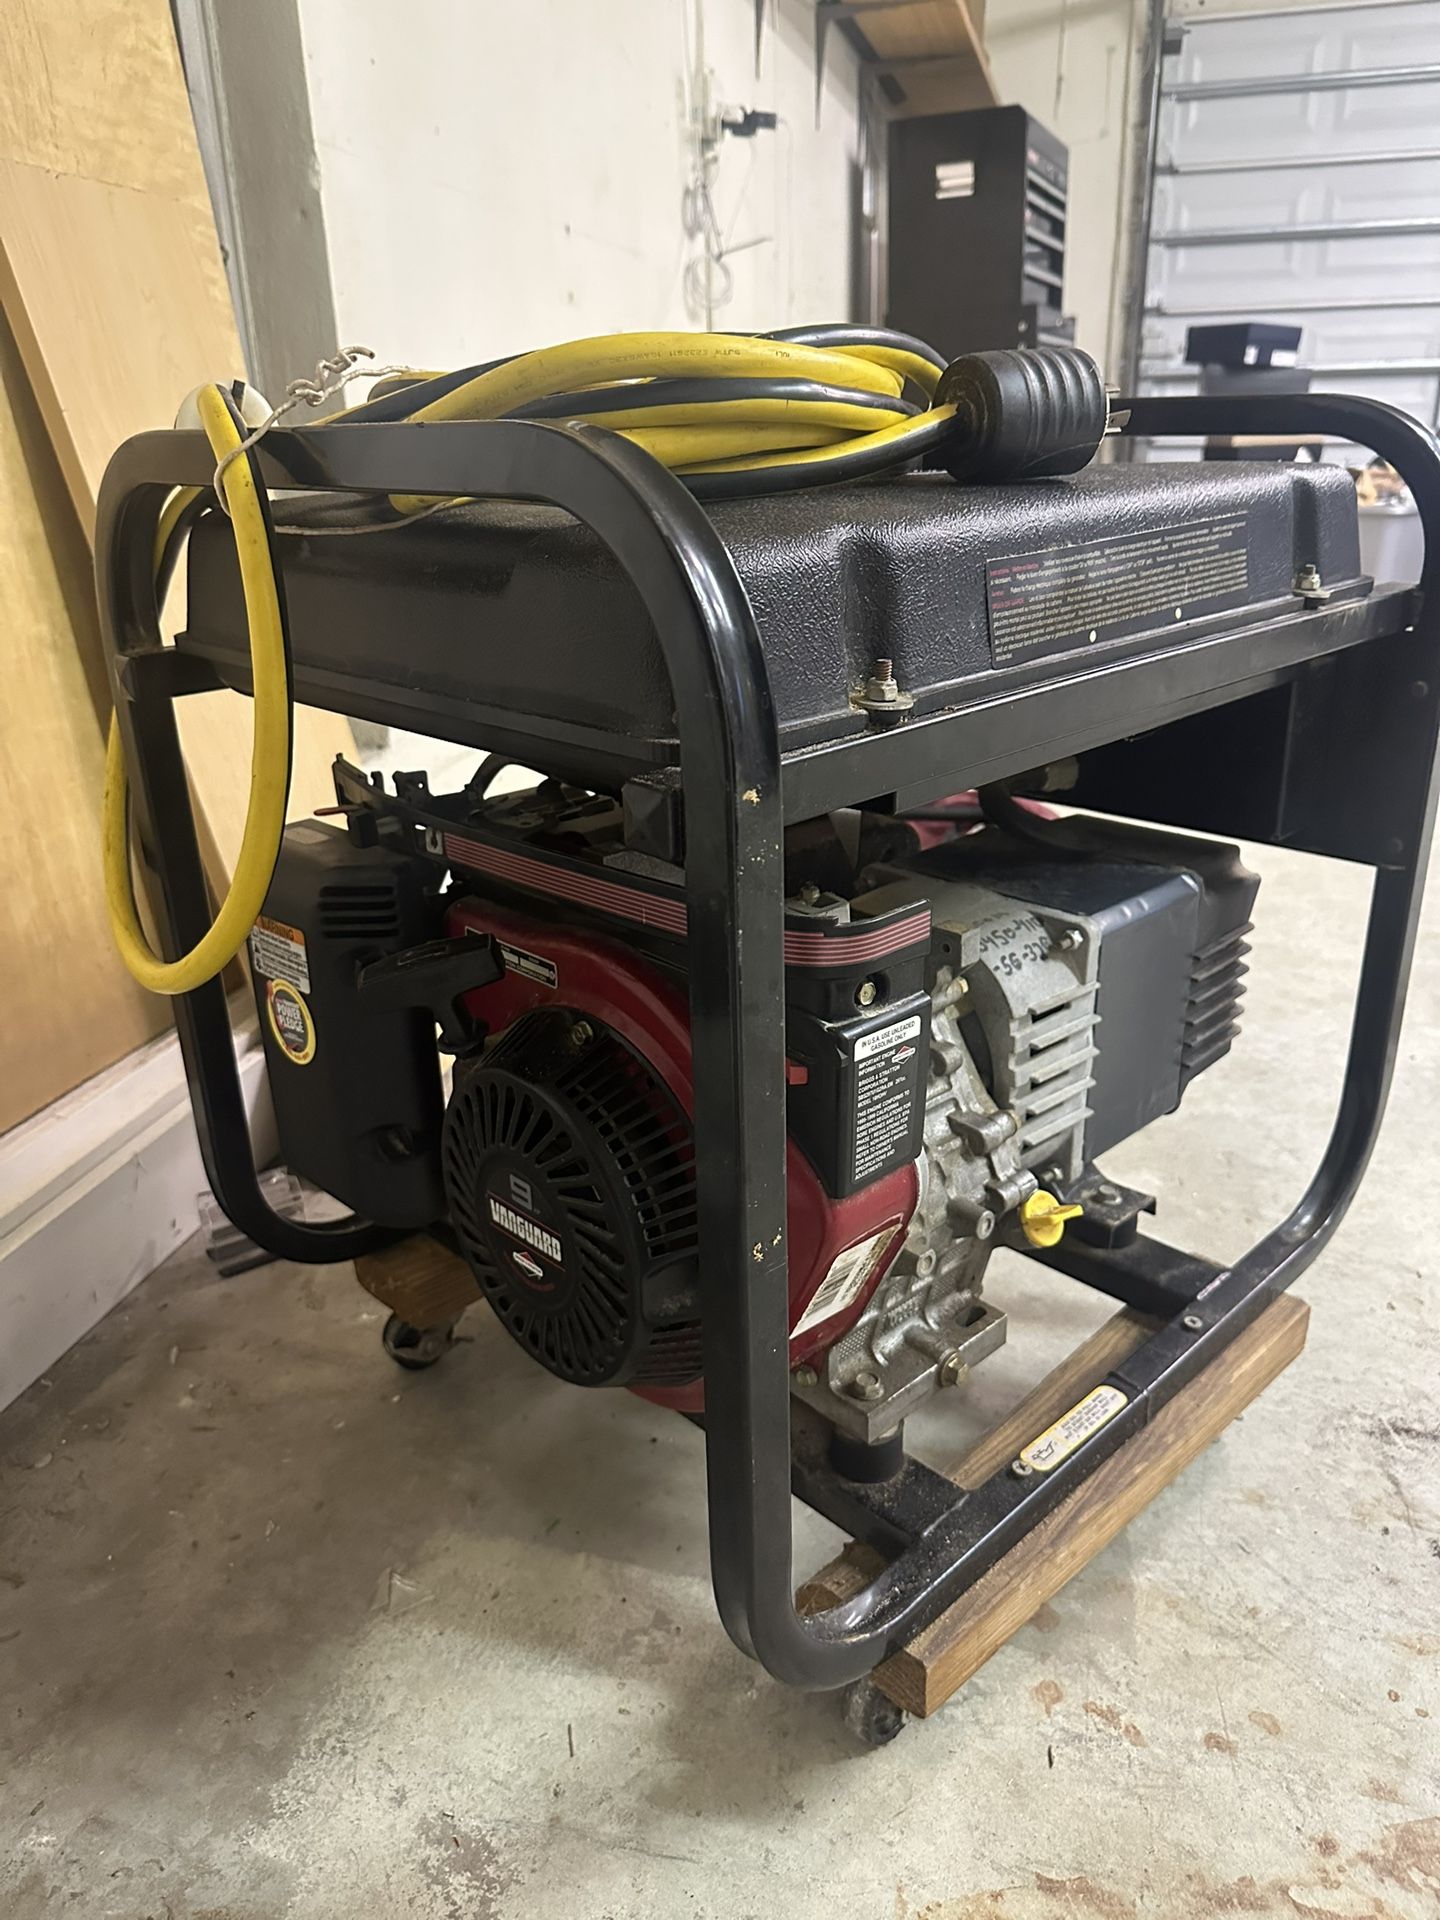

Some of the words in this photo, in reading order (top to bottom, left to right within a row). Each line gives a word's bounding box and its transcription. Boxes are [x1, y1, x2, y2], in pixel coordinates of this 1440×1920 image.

[882, 1031, 890, 1039] USE
[891, 1020, 916, 1036] UNLEADED
[871, 1039, 894, 1051] GASOLINE
[894, 1032, 907, 1041] ONLY
[859, 1055, 881, 1070] IMPORTANT
[882, 1049, 896, 1059] ENGINE
[858, 1075, 875, 1087] BRIGGS
[879, 1064, 901, 1078] STRATTON
[859, 1061, 885, 1077] INFORMATION
[858, 1077, 888, 1094] CORPORATION
[857, 1110, 867, 1118] THIS
[867, 1103, 882, 1114] ENGINE
[882, 1092, 904, 1107] CONFORMS
[876, 1102, 899, 1116] CALIFORNIA
[876, 1106, 903, 1122] REGULATIONS
[868, 1121, 886, 1134] ENGINES
[873, 1121, 900, 1137] REGULATIONS
[864, 1144, 892, 1162] MAINTENANCE
[510, 1174, 533, 1211] 9
[489, 1198, 562, 1262] VANGUARD
